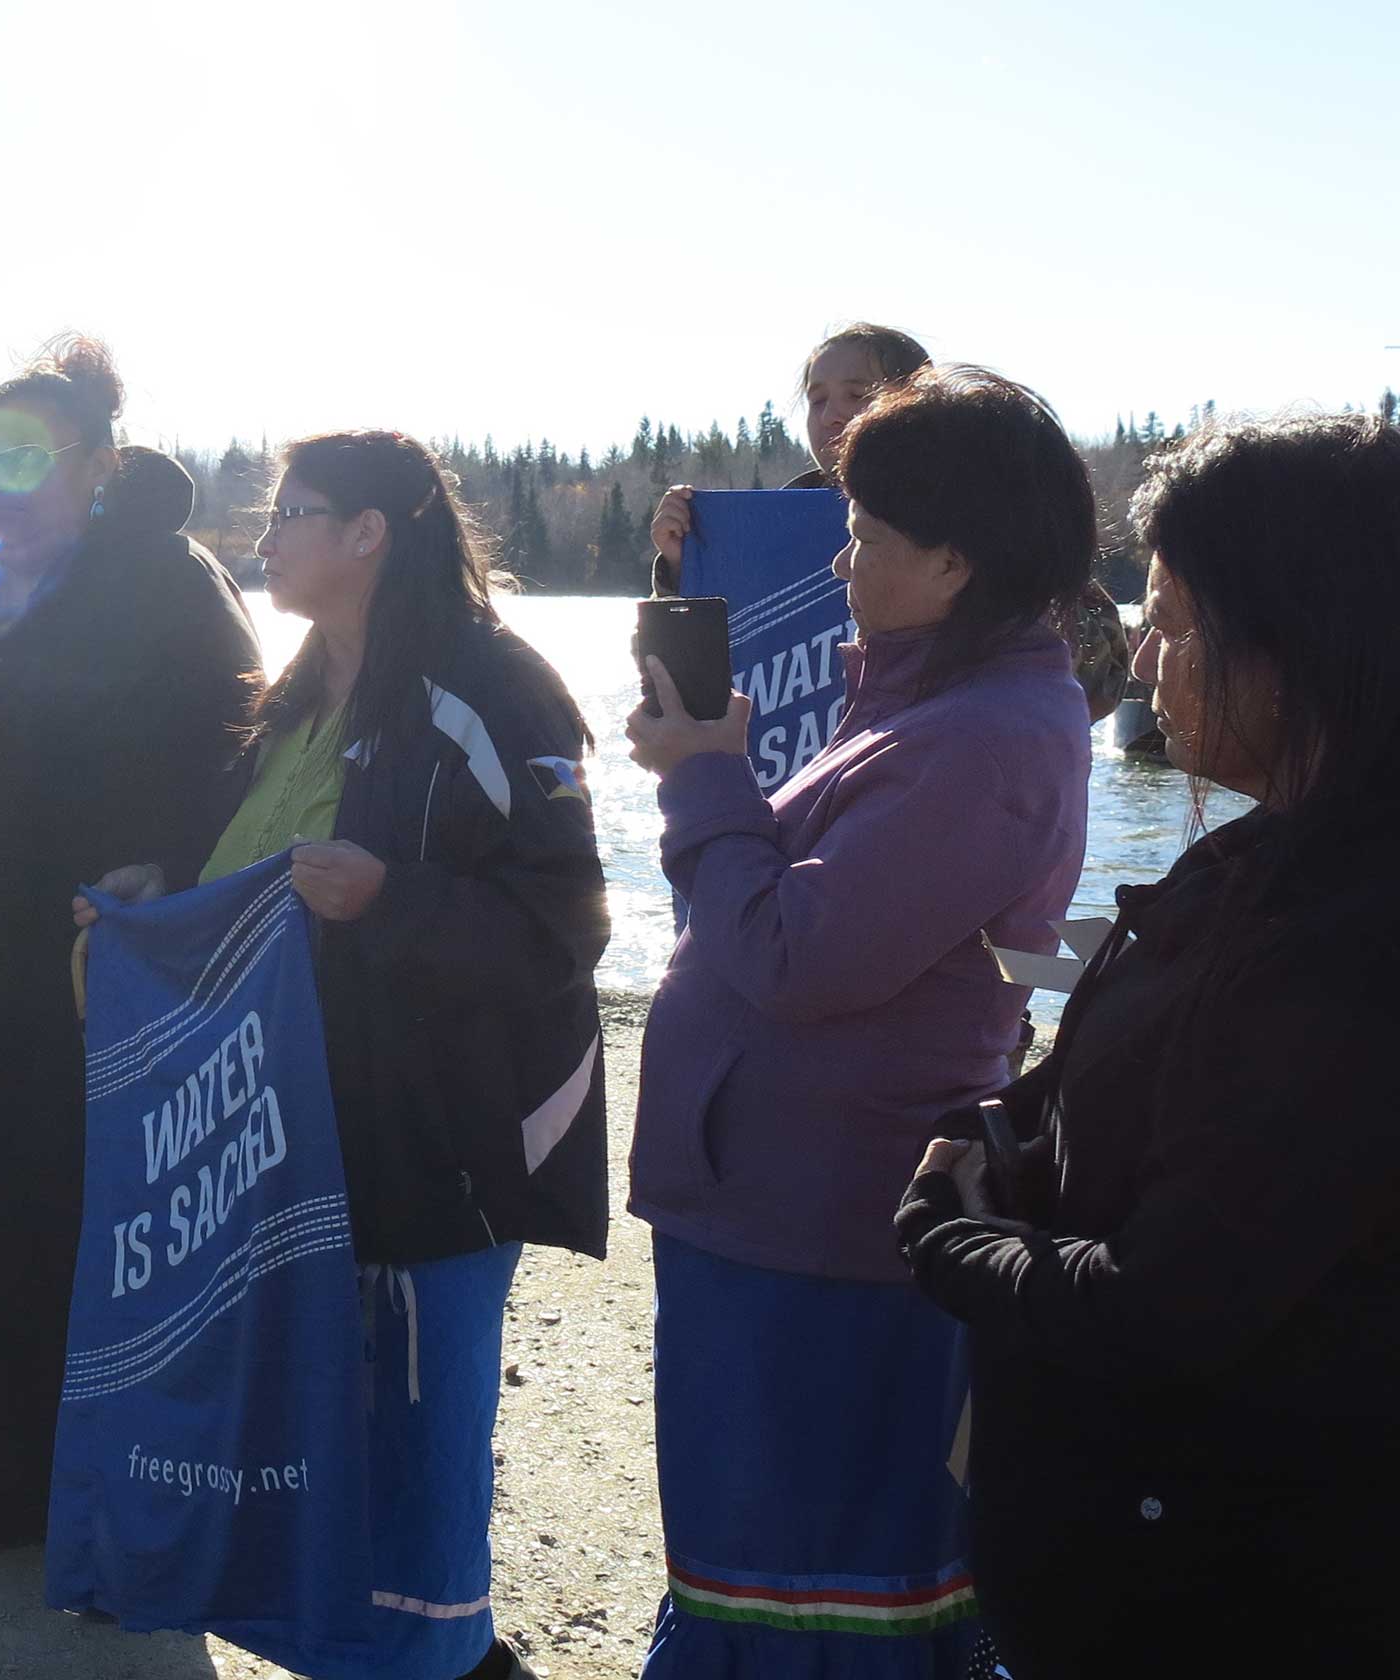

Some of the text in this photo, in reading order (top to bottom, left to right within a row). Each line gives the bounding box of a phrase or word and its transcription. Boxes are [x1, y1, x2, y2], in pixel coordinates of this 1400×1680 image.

[732, 620, 857, 717] WAT
[142, 1010, 265, 1185] WATER
[111, 1211, 153, 1298] IS
[128, 1443, 310, 1505] freegrassy.net
